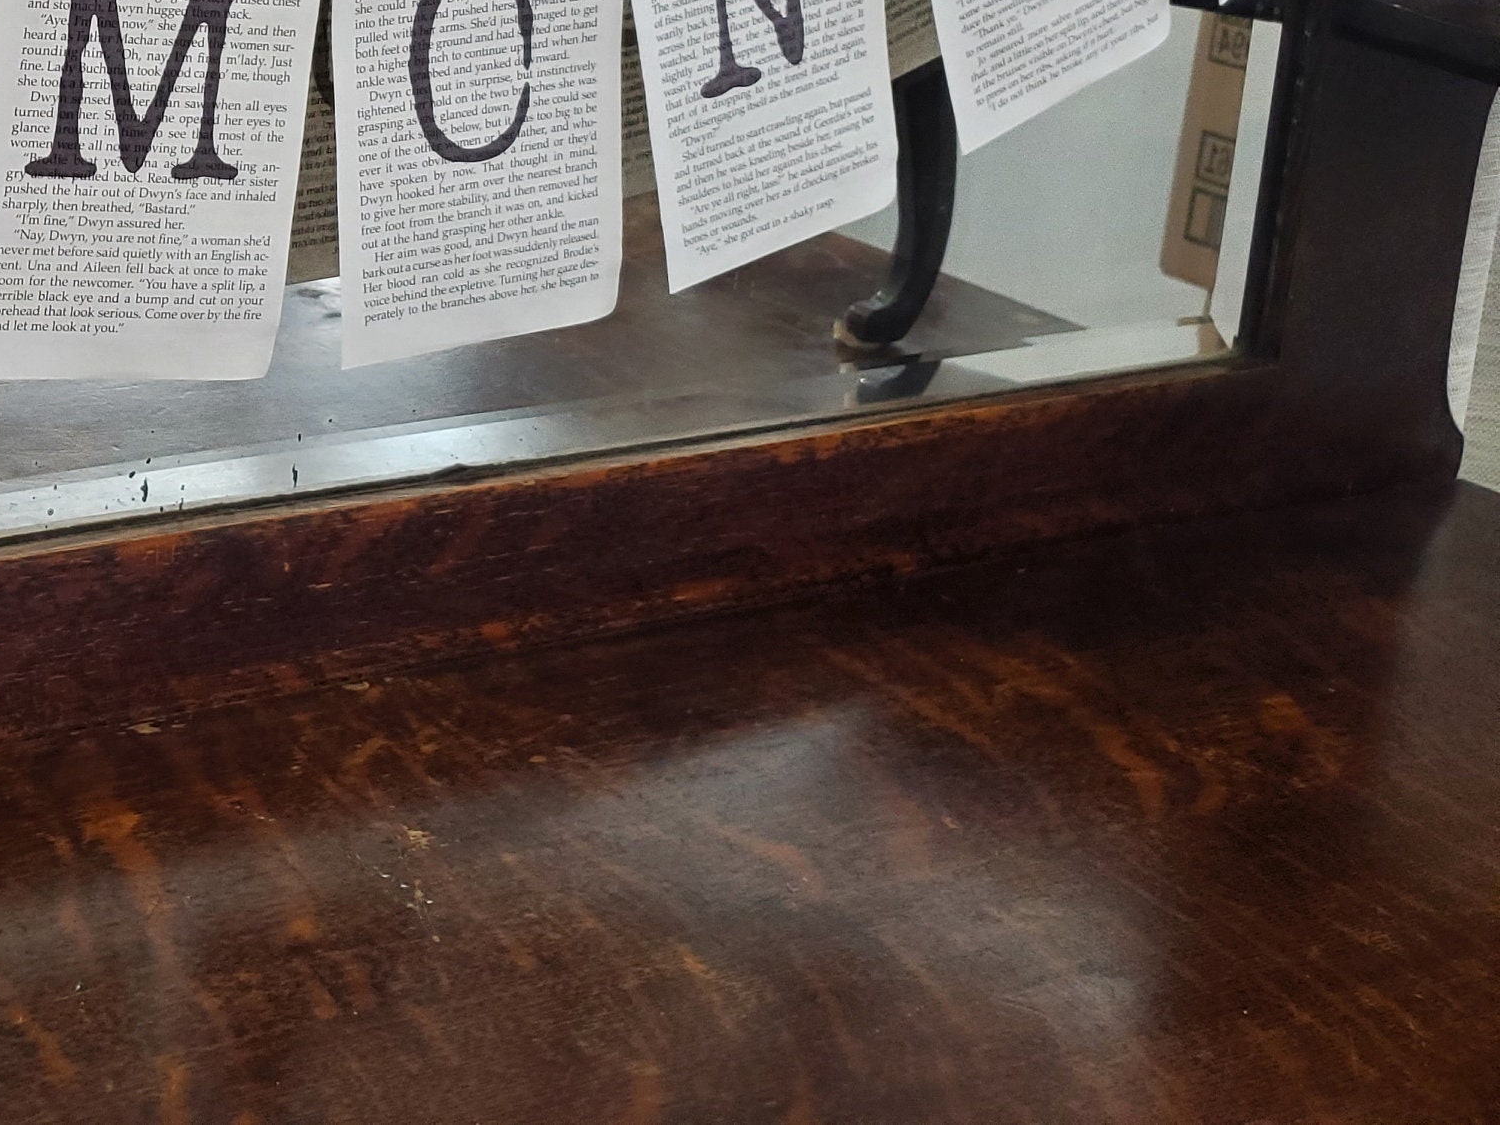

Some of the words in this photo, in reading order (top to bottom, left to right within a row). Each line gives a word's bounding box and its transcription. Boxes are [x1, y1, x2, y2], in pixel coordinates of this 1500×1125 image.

[681, 216, 708, 235] hands
[709, 205, 744, 224] moving
[744, 197, 765, 211] over
[765, 191, 781, 203] her
[781, 188, 792, 197] as
[793, 182, 800, 194] if
[801, 170, 839, 190] checking
[836, 165, 851, 176] for
[849, 154, 879, 171] broken
[364, 306, 405, 327] perately
[408, 306, 419, 316] to
[421, 300, 438, 313] the
[440, 293, 487, 310] branches
[488, 289, 519, 301] above
[520, 284, 538, 296] her,
[540, 279, 557, 291] she
[559, 275, 588, 288] began
[590, 273, 600, 281] to
